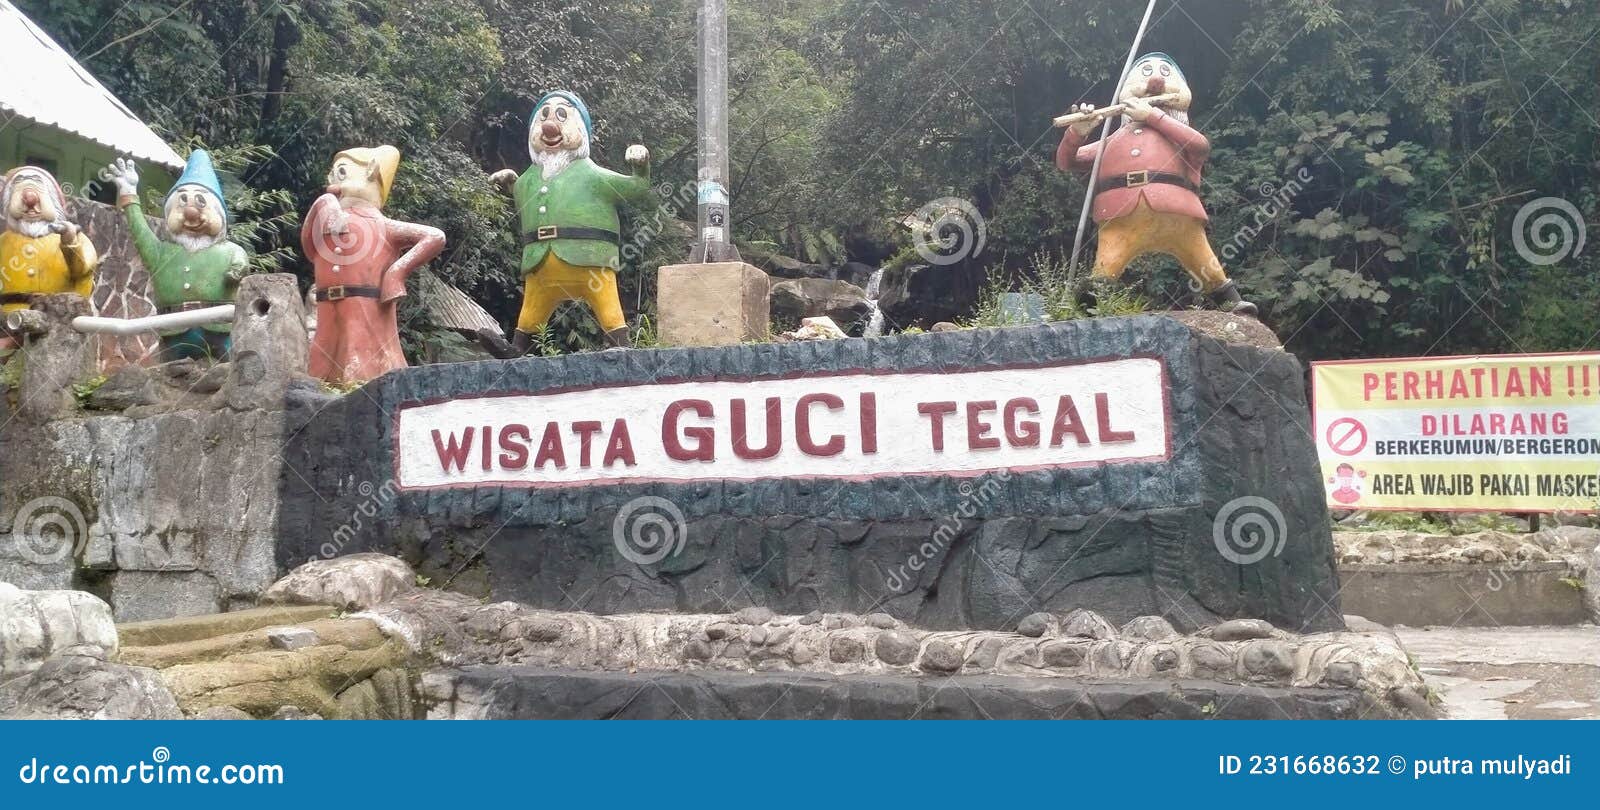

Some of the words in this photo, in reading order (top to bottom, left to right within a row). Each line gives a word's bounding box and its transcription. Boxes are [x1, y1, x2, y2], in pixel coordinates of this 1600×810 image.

[1363, 365, 1552, 401] PERHATIAN
[431, 418, 638, 472] WISATA
[661, 391, 878, 463] GUCI
[917, 392, 1136, 452] TEGAL
[1421, 412, 1569, 437] DILARANG
[1372, 474, 1415, 496] AREA
[1420, 474, 1474, 496] WAJIB
[1480, 474, 1530, 496] PAKAI
[1536, 474, 1600, 497] MASKE
